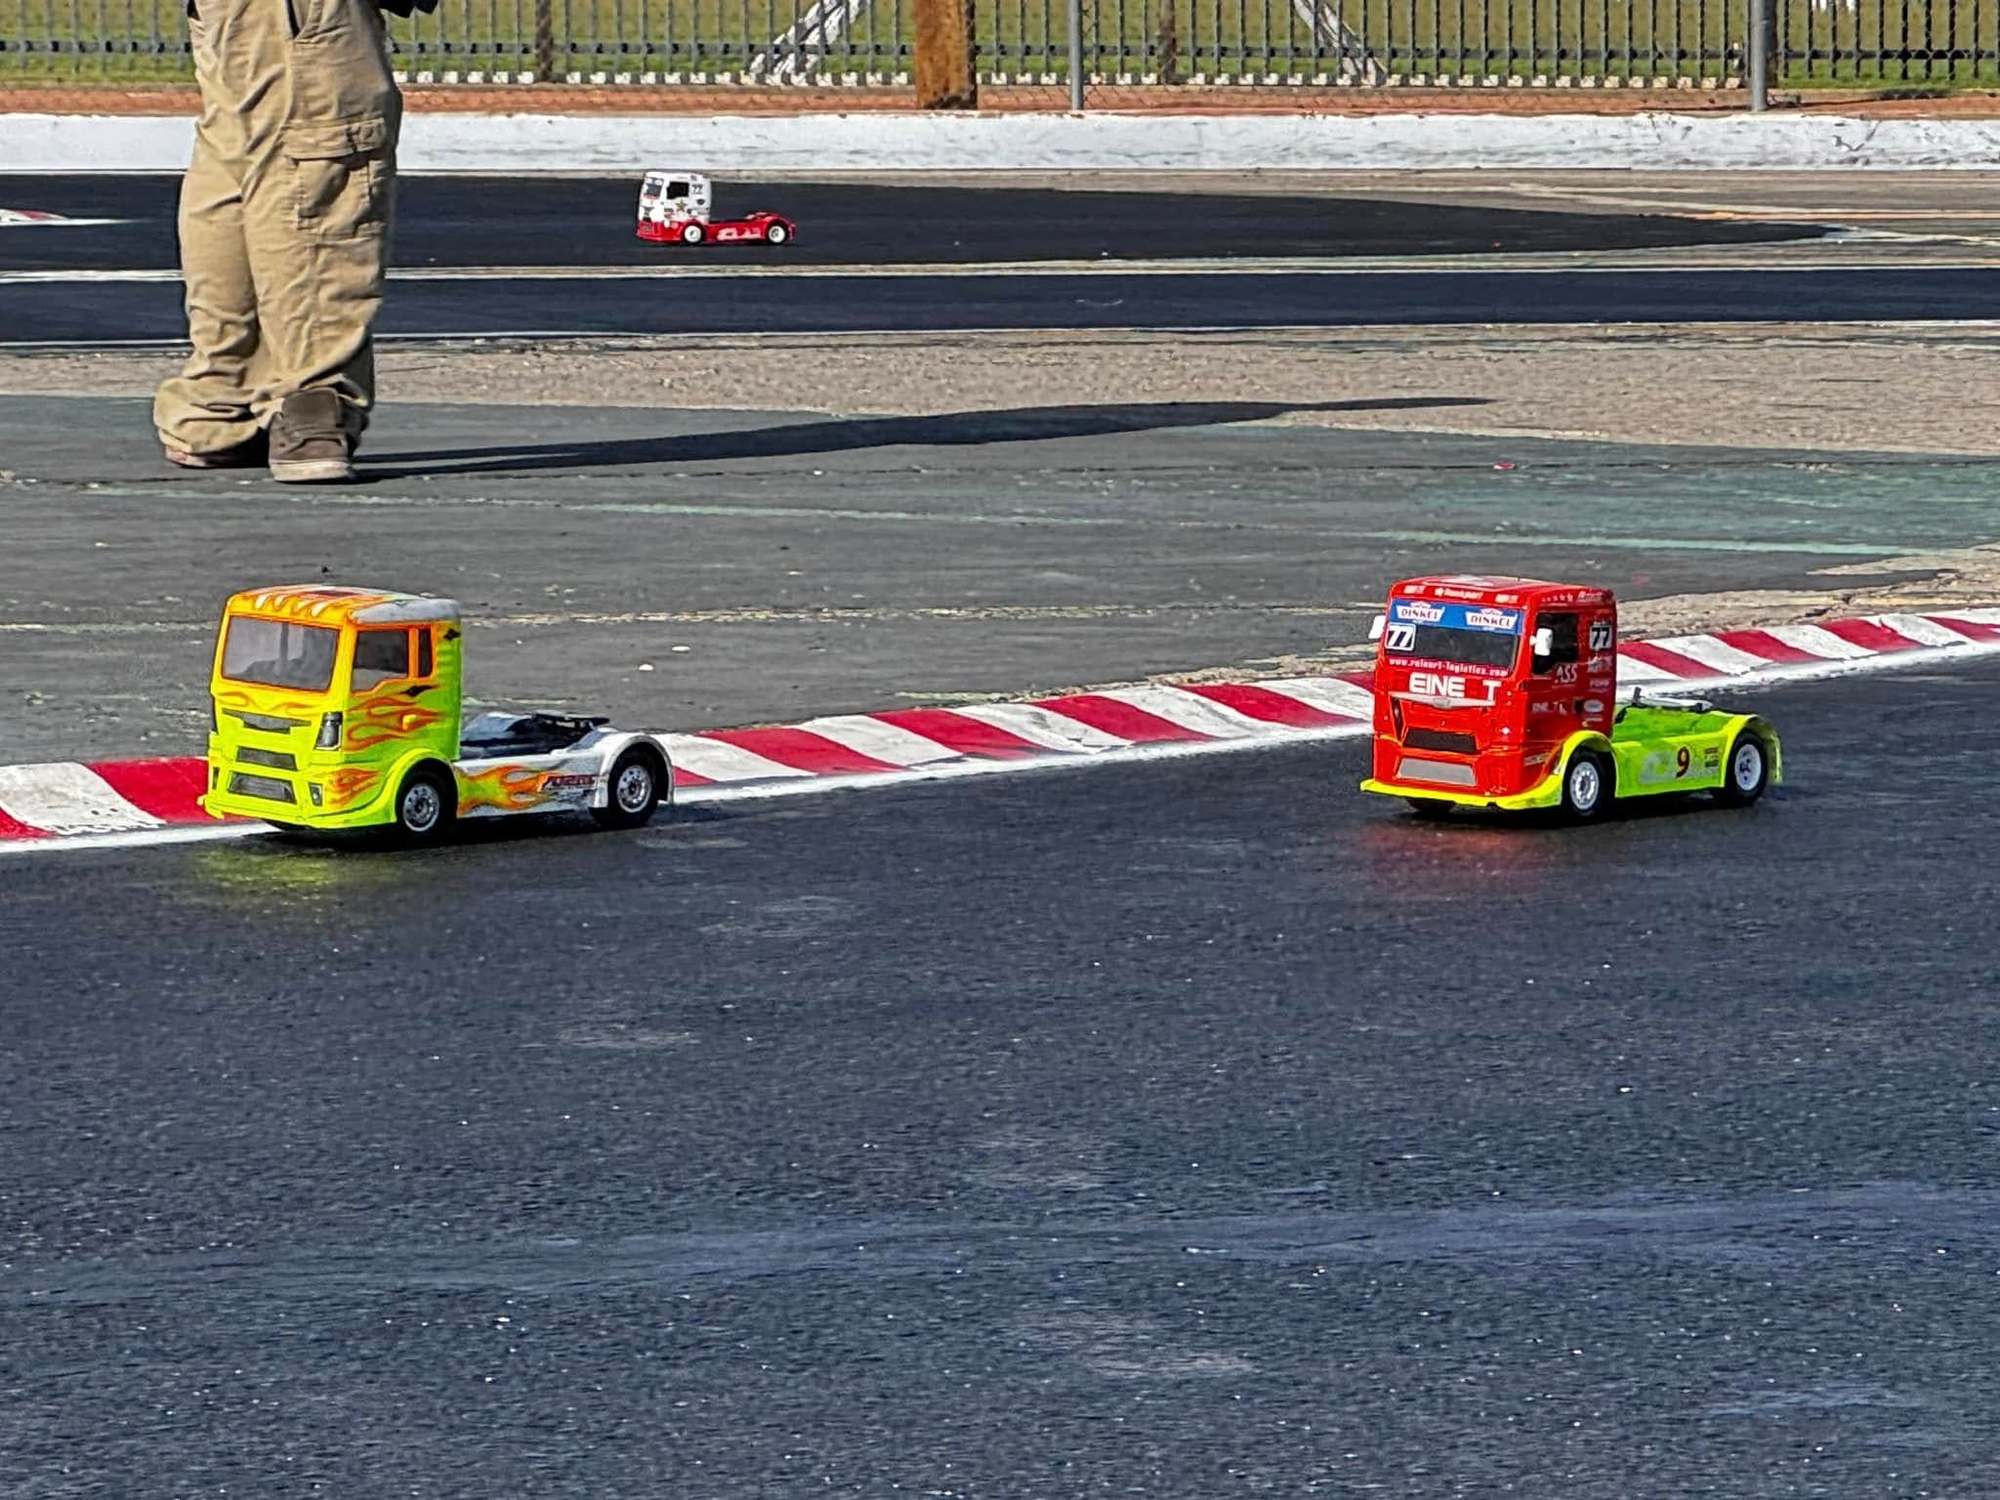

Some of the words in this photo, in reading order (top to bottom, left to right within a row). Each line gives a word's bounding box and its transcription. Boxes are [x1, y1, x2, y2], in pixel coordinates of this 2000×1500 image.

[1401, 608, 1439, 620] DINKEL
[1470, 615, 1511, 628] DINKEL
[1387, 625, 1413, 649] 77
[1591, 627, 1610, 647] 77
[1409, 672, 1466, 698] EINE
[1675, 746, 1690, 778] 9
